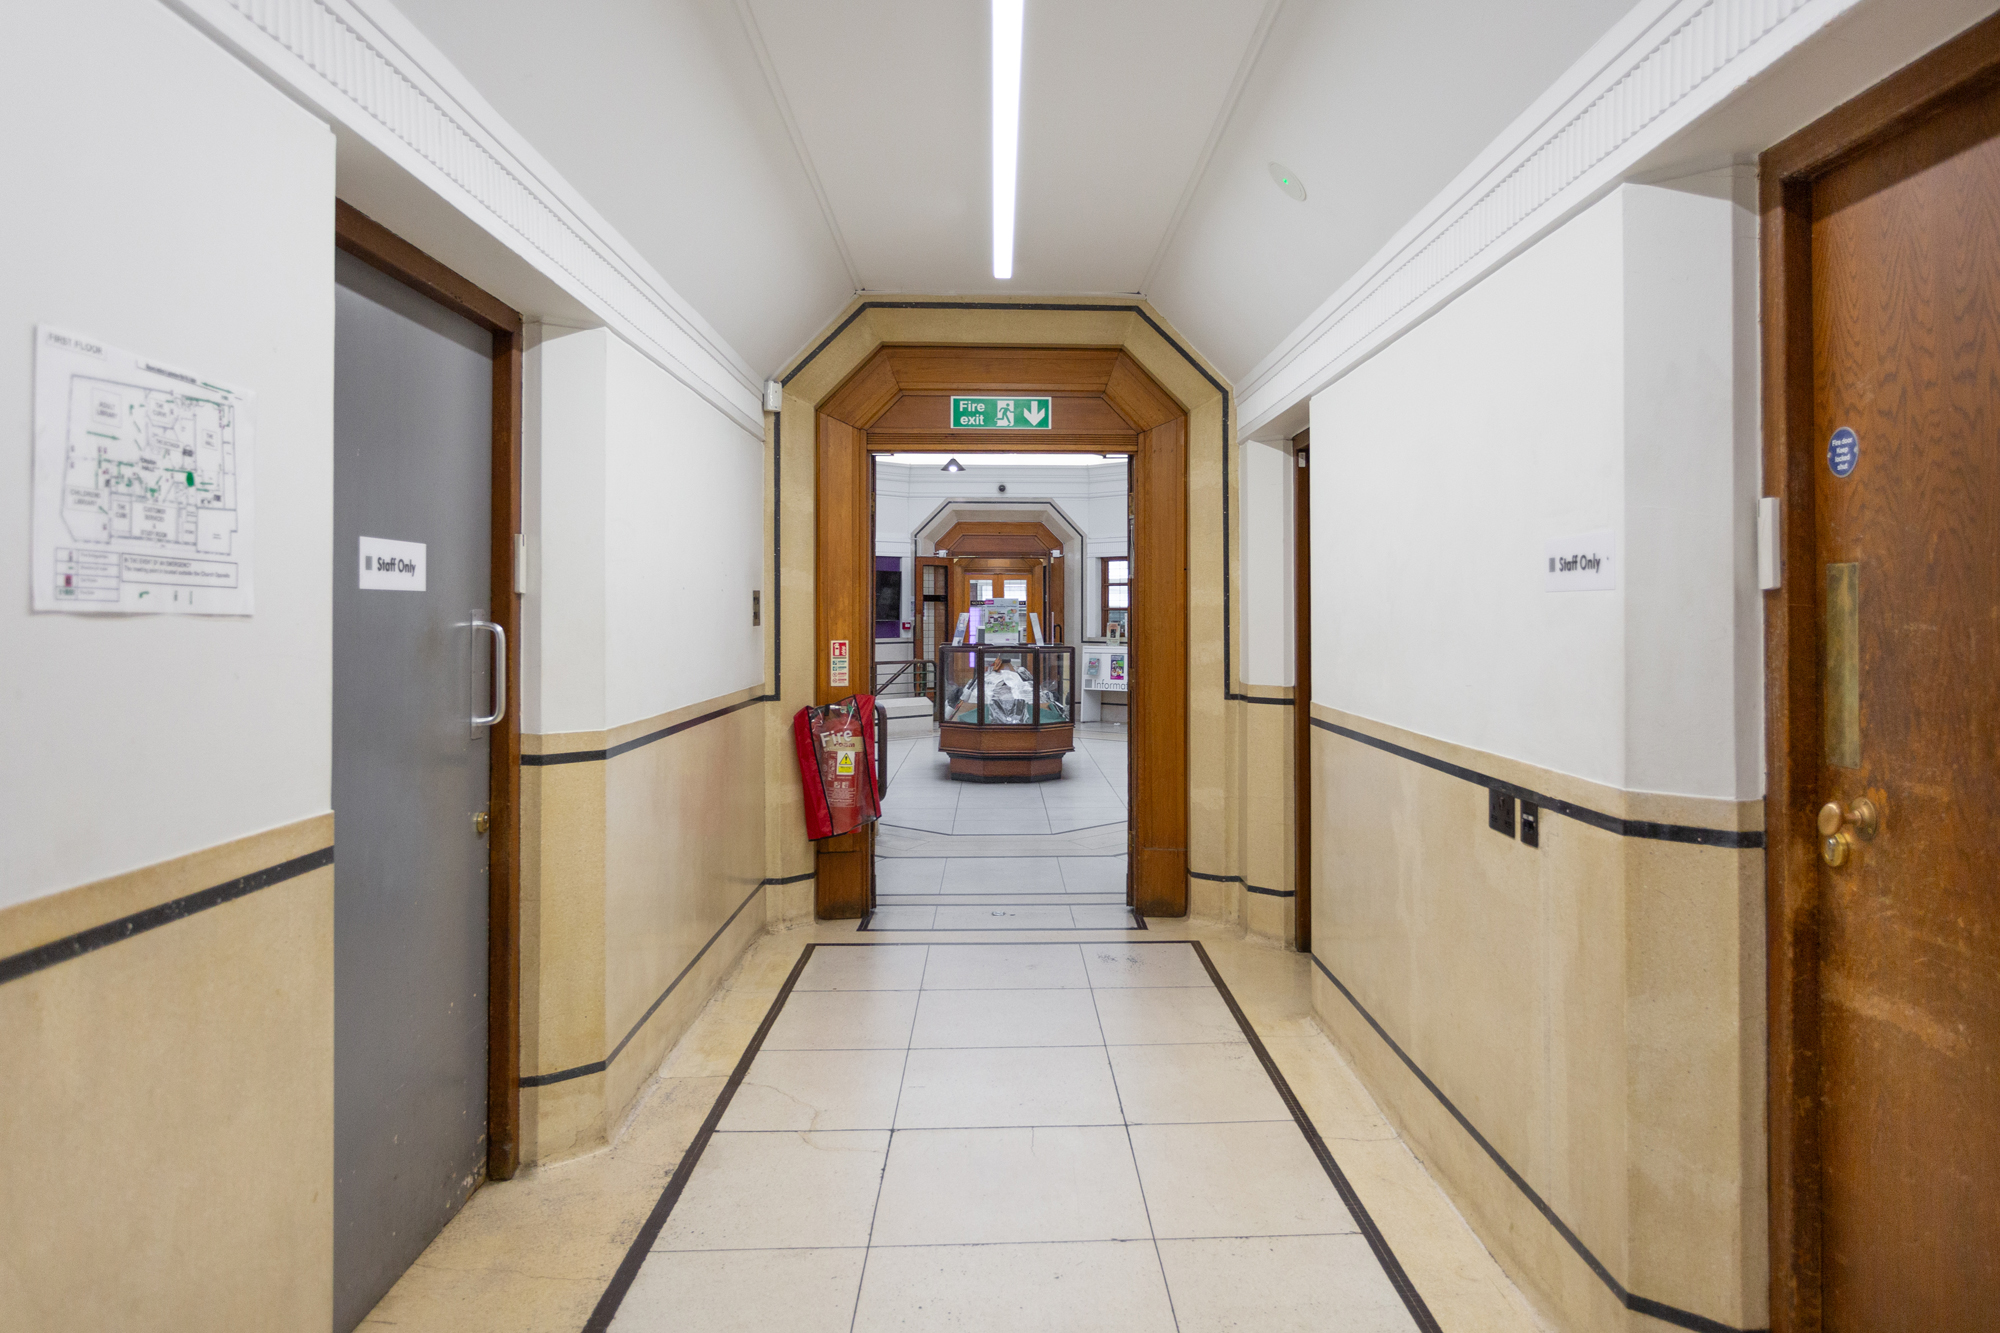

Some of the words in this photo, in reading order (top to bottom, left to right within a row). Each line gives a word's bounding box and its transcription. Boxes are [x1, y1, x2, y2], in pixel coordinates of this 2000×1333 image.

[959, 400, 986, 413] Fire
[960, 414, 985, 426] exit
[1841, 437, 1853, 445] door
[1834, 453, 1851, 463] locked
[1836, 462, 1848, 471] shut
[377, 556, 397, 573] Staff
[397, 558, 417, 578] Only
[1558, 554, 1578, 573] Staff
[1580, 552, 1601, 574] Only
[1094, 679, 1128, 691] Informa
[820, 730, 852, 748] Fire
